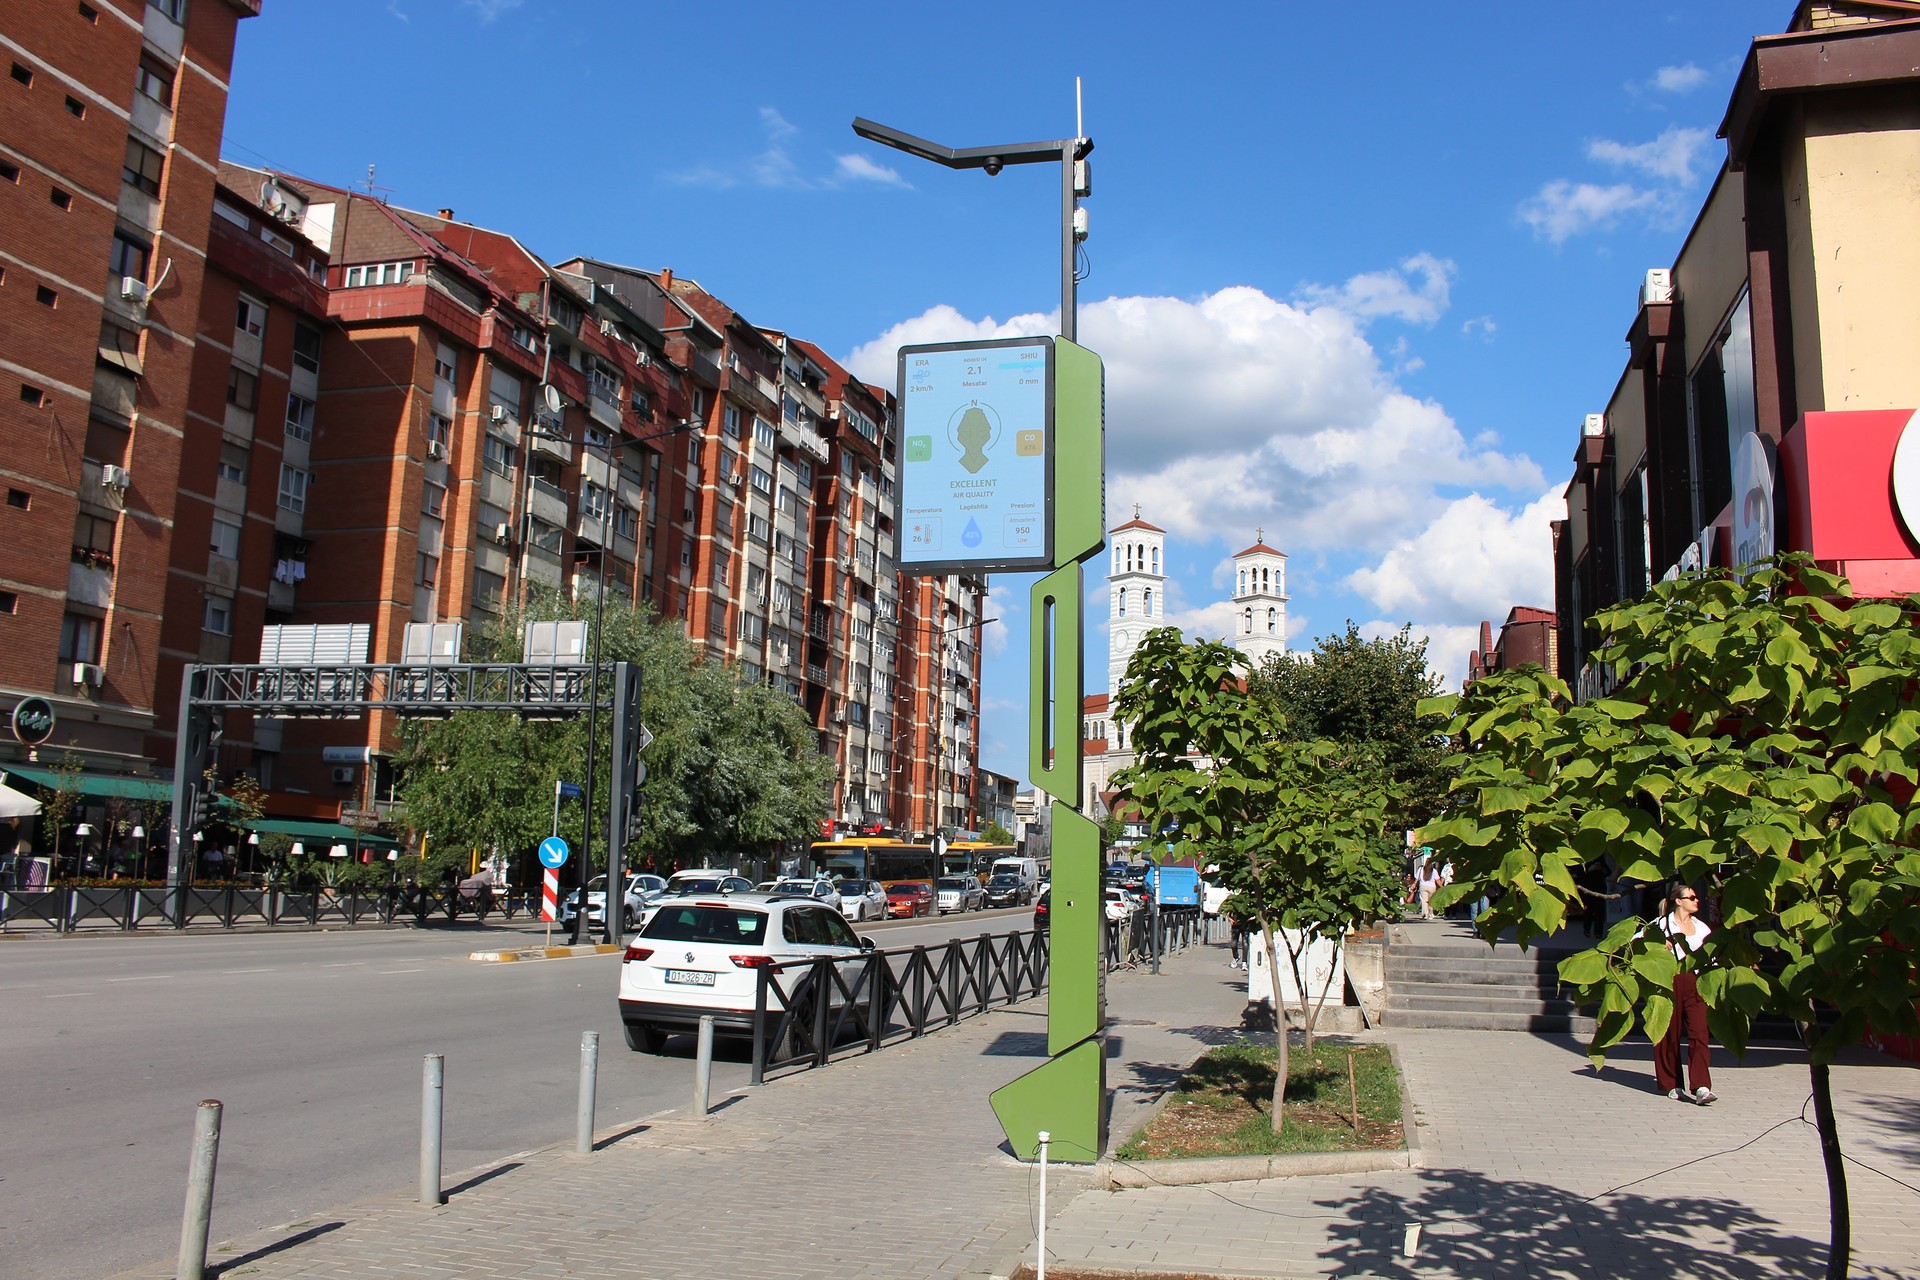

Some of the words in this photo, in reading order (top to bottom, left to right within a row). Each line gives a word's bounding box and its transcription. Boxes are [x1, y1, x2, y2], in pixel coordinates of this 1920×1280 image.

[1020, 352, 1038, 360] SHIU
[915, 359, 929, 367] ERA
[967, 366, 983, 375] 2.1
[962, 380, 988, 388] Mesatar
[910, 385, 916, 393] 2
[916, 384, 934, 392] km/h
[971, 399, 978, 407] N
[950, 478, 998, 489] EXCELLENT
[965, 490, 994, 499] QUALITY
[1015, 527, 1031, 535] 950
[912, 535, 922, 543] 26
